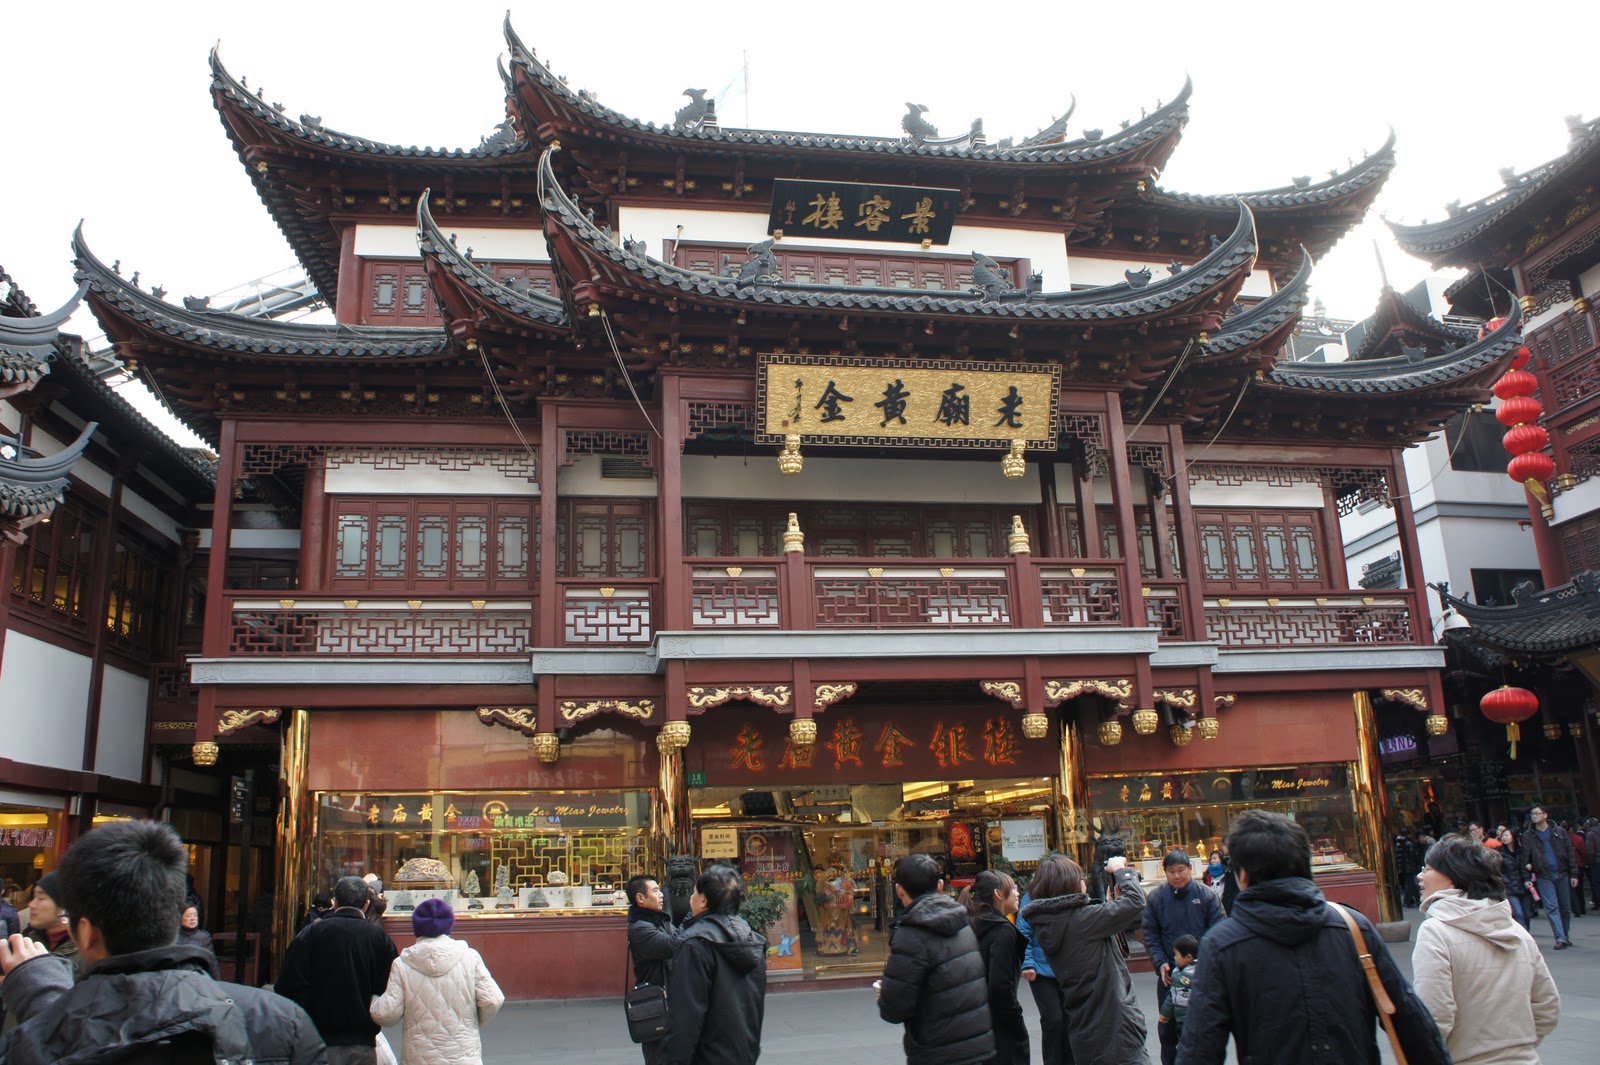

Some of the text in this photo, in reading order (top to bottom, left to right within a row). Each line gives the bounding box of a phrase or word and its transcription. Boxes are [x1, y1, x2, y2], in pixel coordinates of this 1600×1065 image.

[692, 773, 701, 781] 18
[1271, 780, 1295, 789] Miao
[1297, 778, 1329, 789] Jewelry
[1120, 782, 1195, 802] 老庙黄金
[366, 803, 463, 824] 老庙黄金
[529, 805, 631, 817] Lao Miao Jewelry
